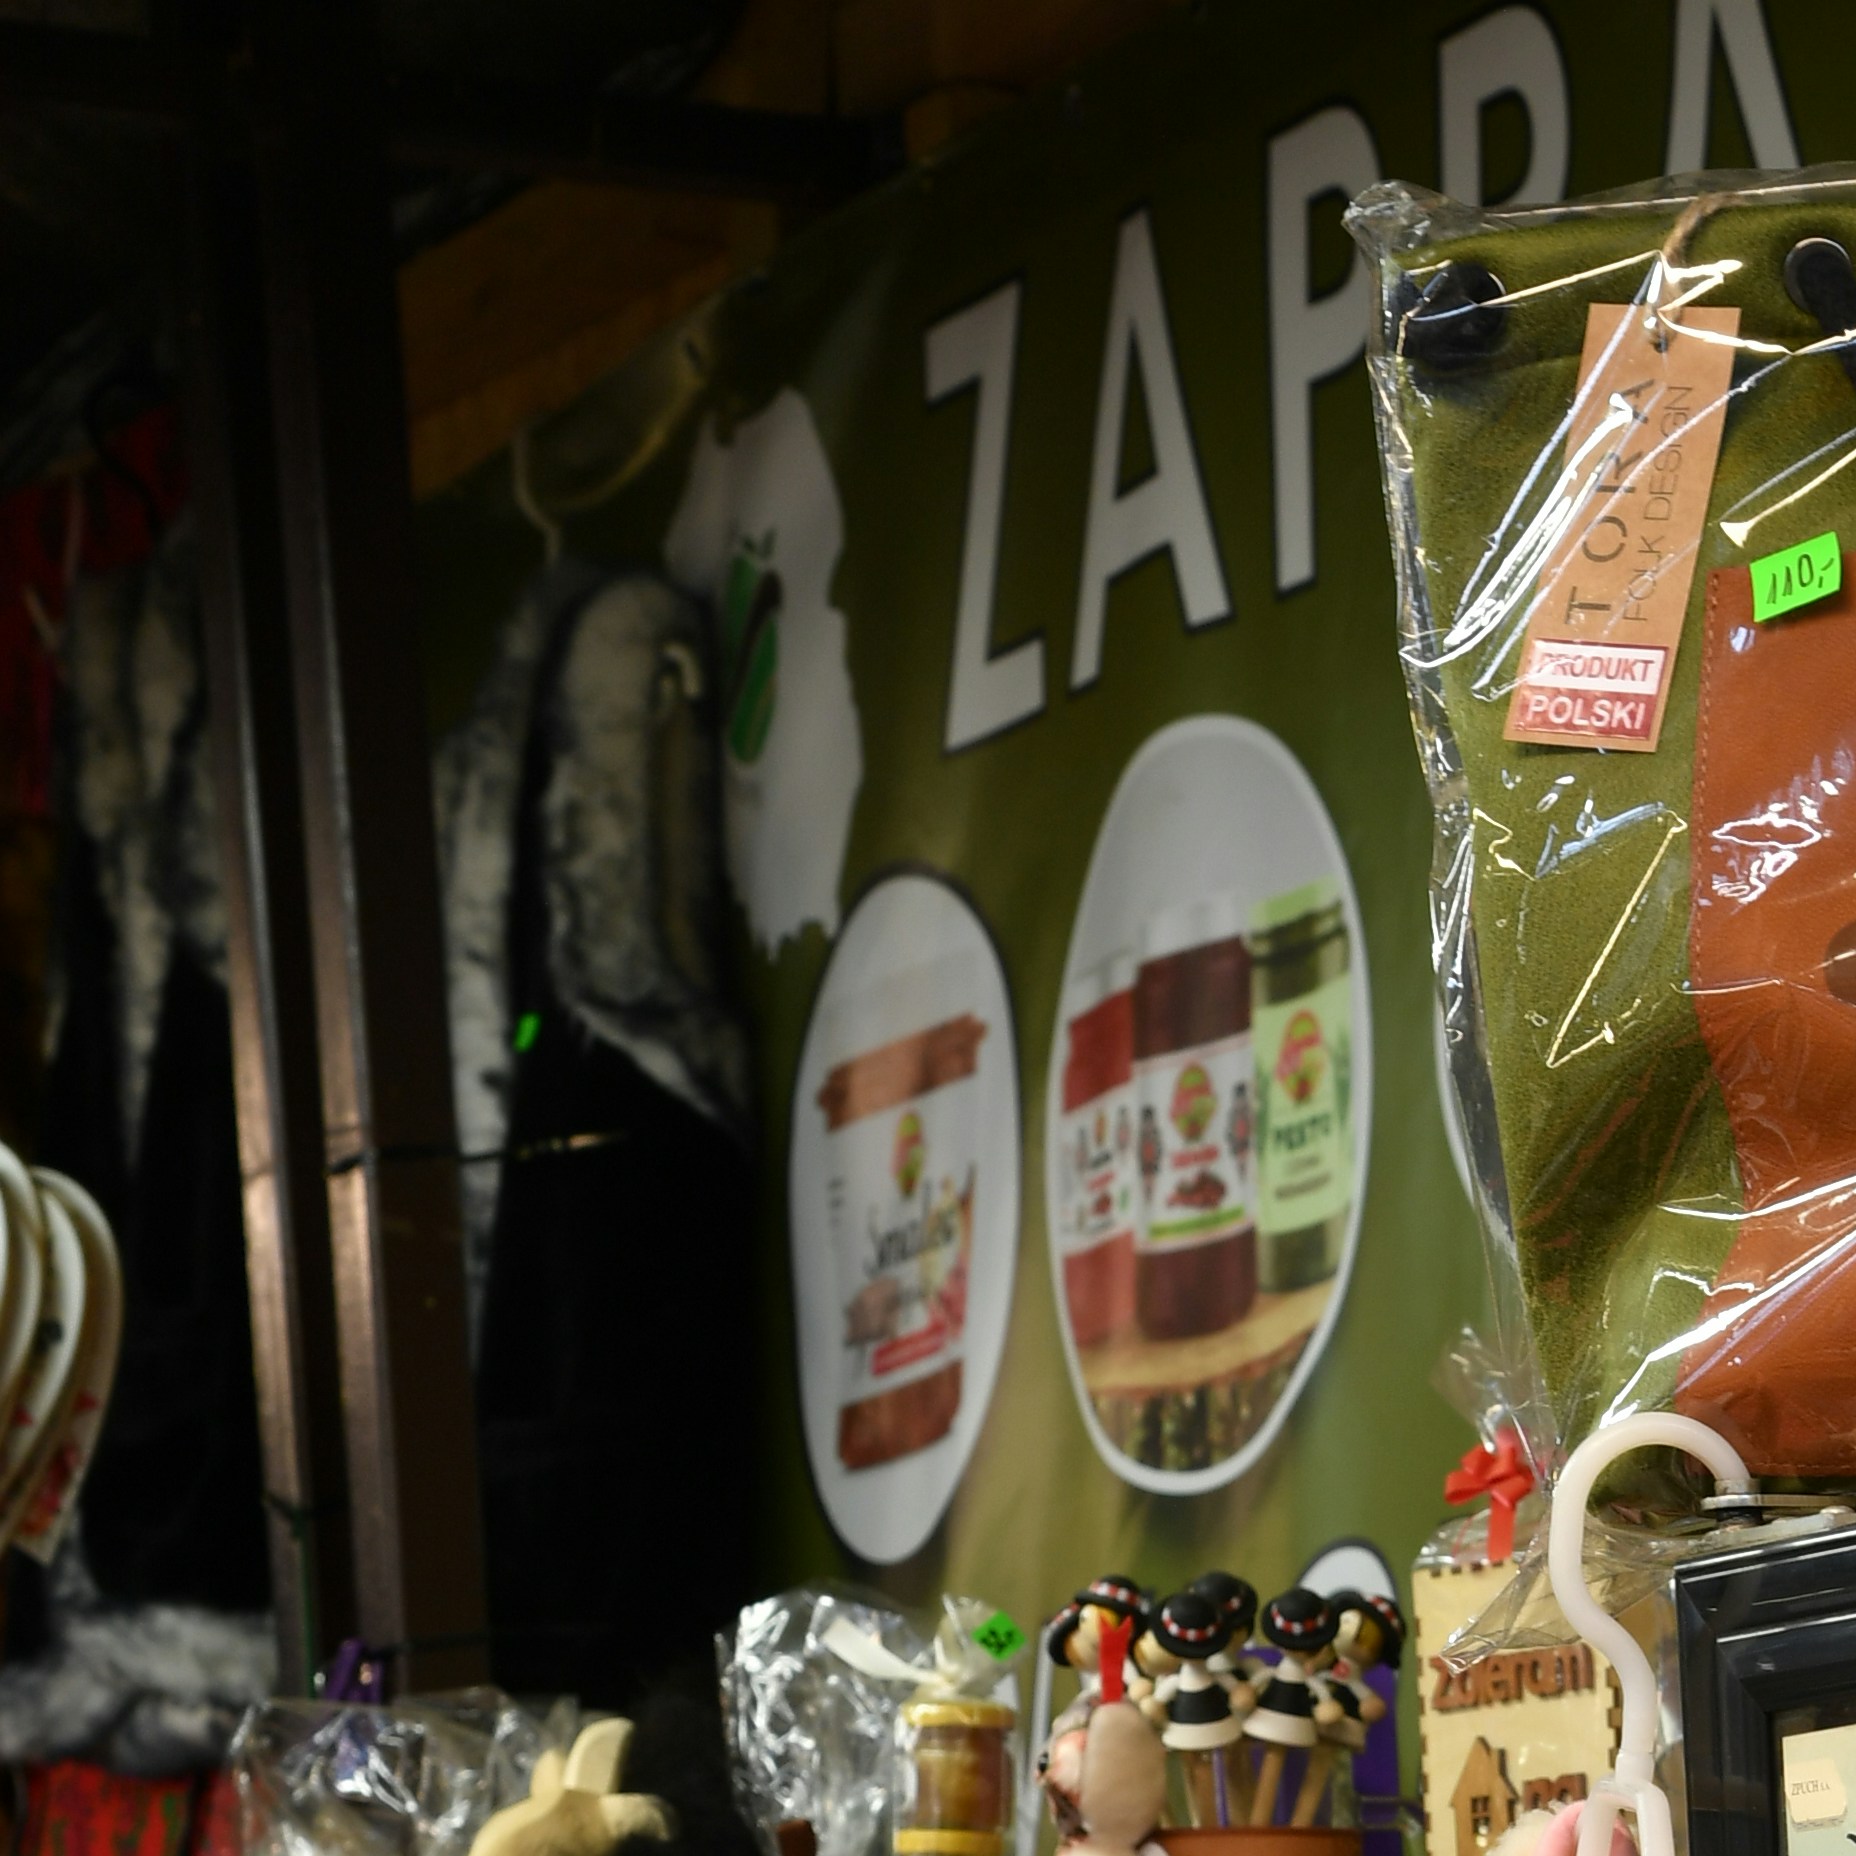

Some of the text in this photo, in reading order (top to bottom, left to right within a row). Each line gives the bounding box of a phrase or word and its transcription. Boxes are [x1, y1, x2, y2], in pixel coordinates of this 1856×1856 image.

[1565, 378, 1656, 626] TORA
[1622, 384, 1696, 623] FOLK DESIGN
[1526, 694, 1646, 732] POLSKI
[1537, 651, 1657, 684] PRODUKT
